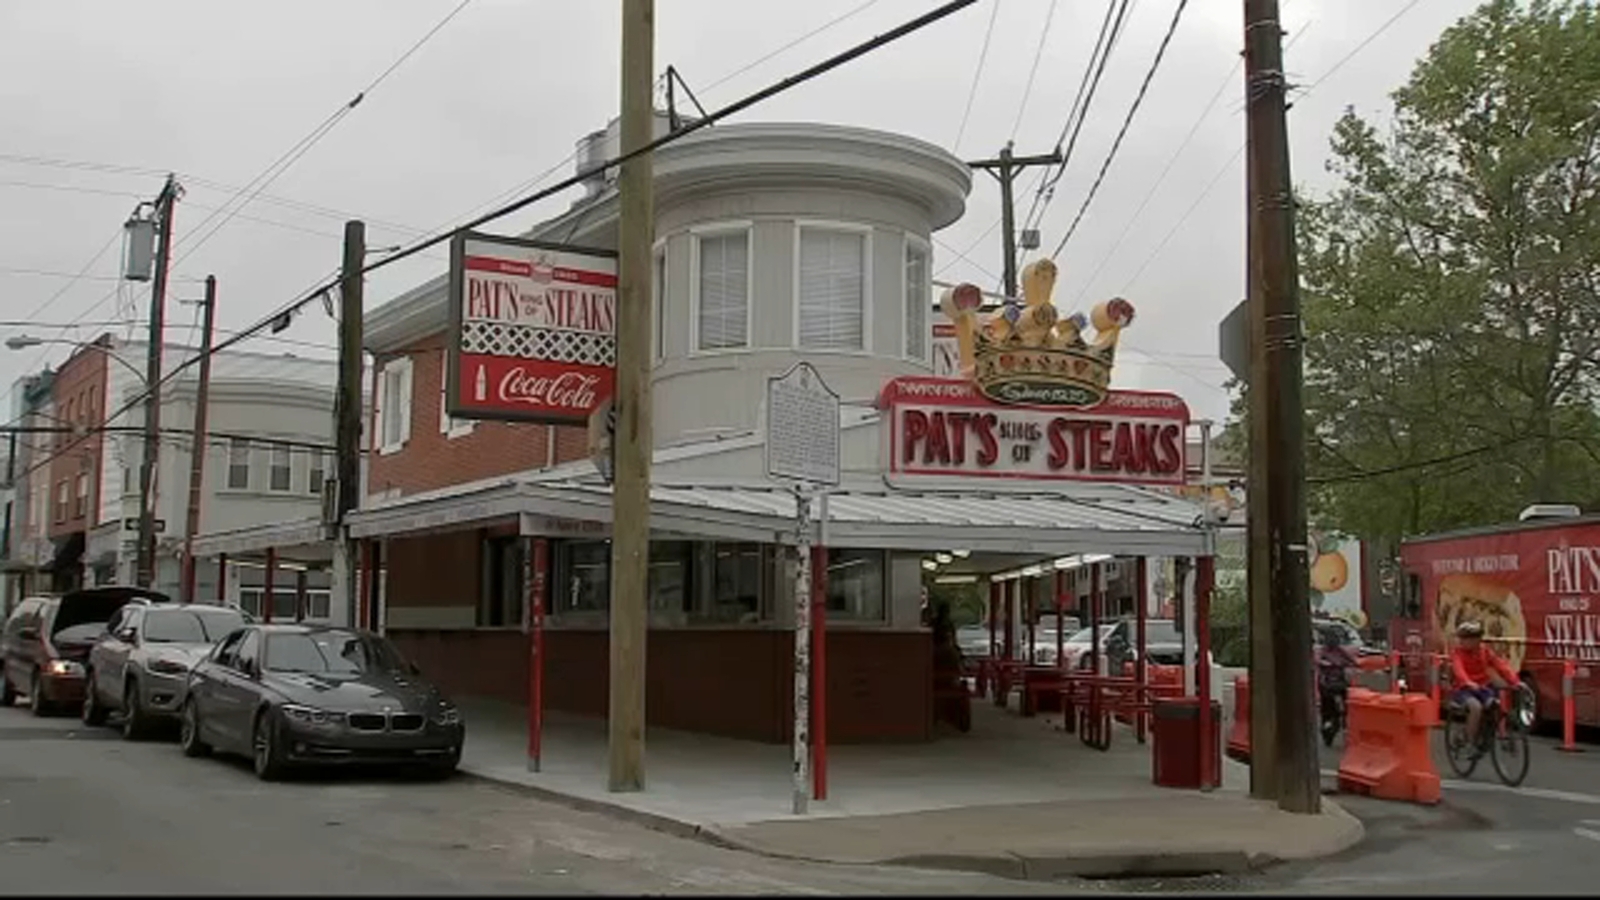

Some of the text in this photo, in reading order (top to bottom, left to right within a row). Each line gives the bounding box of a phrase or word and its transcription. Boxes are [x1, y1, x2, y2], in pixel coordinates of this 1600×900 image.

[469, 278, 519, 320] PAT'S
[545, 289, 613, 332] STEAKS
[903, 409, 998, 467] PAT'S
[1047, 417, 1181, 475] STEAKS
